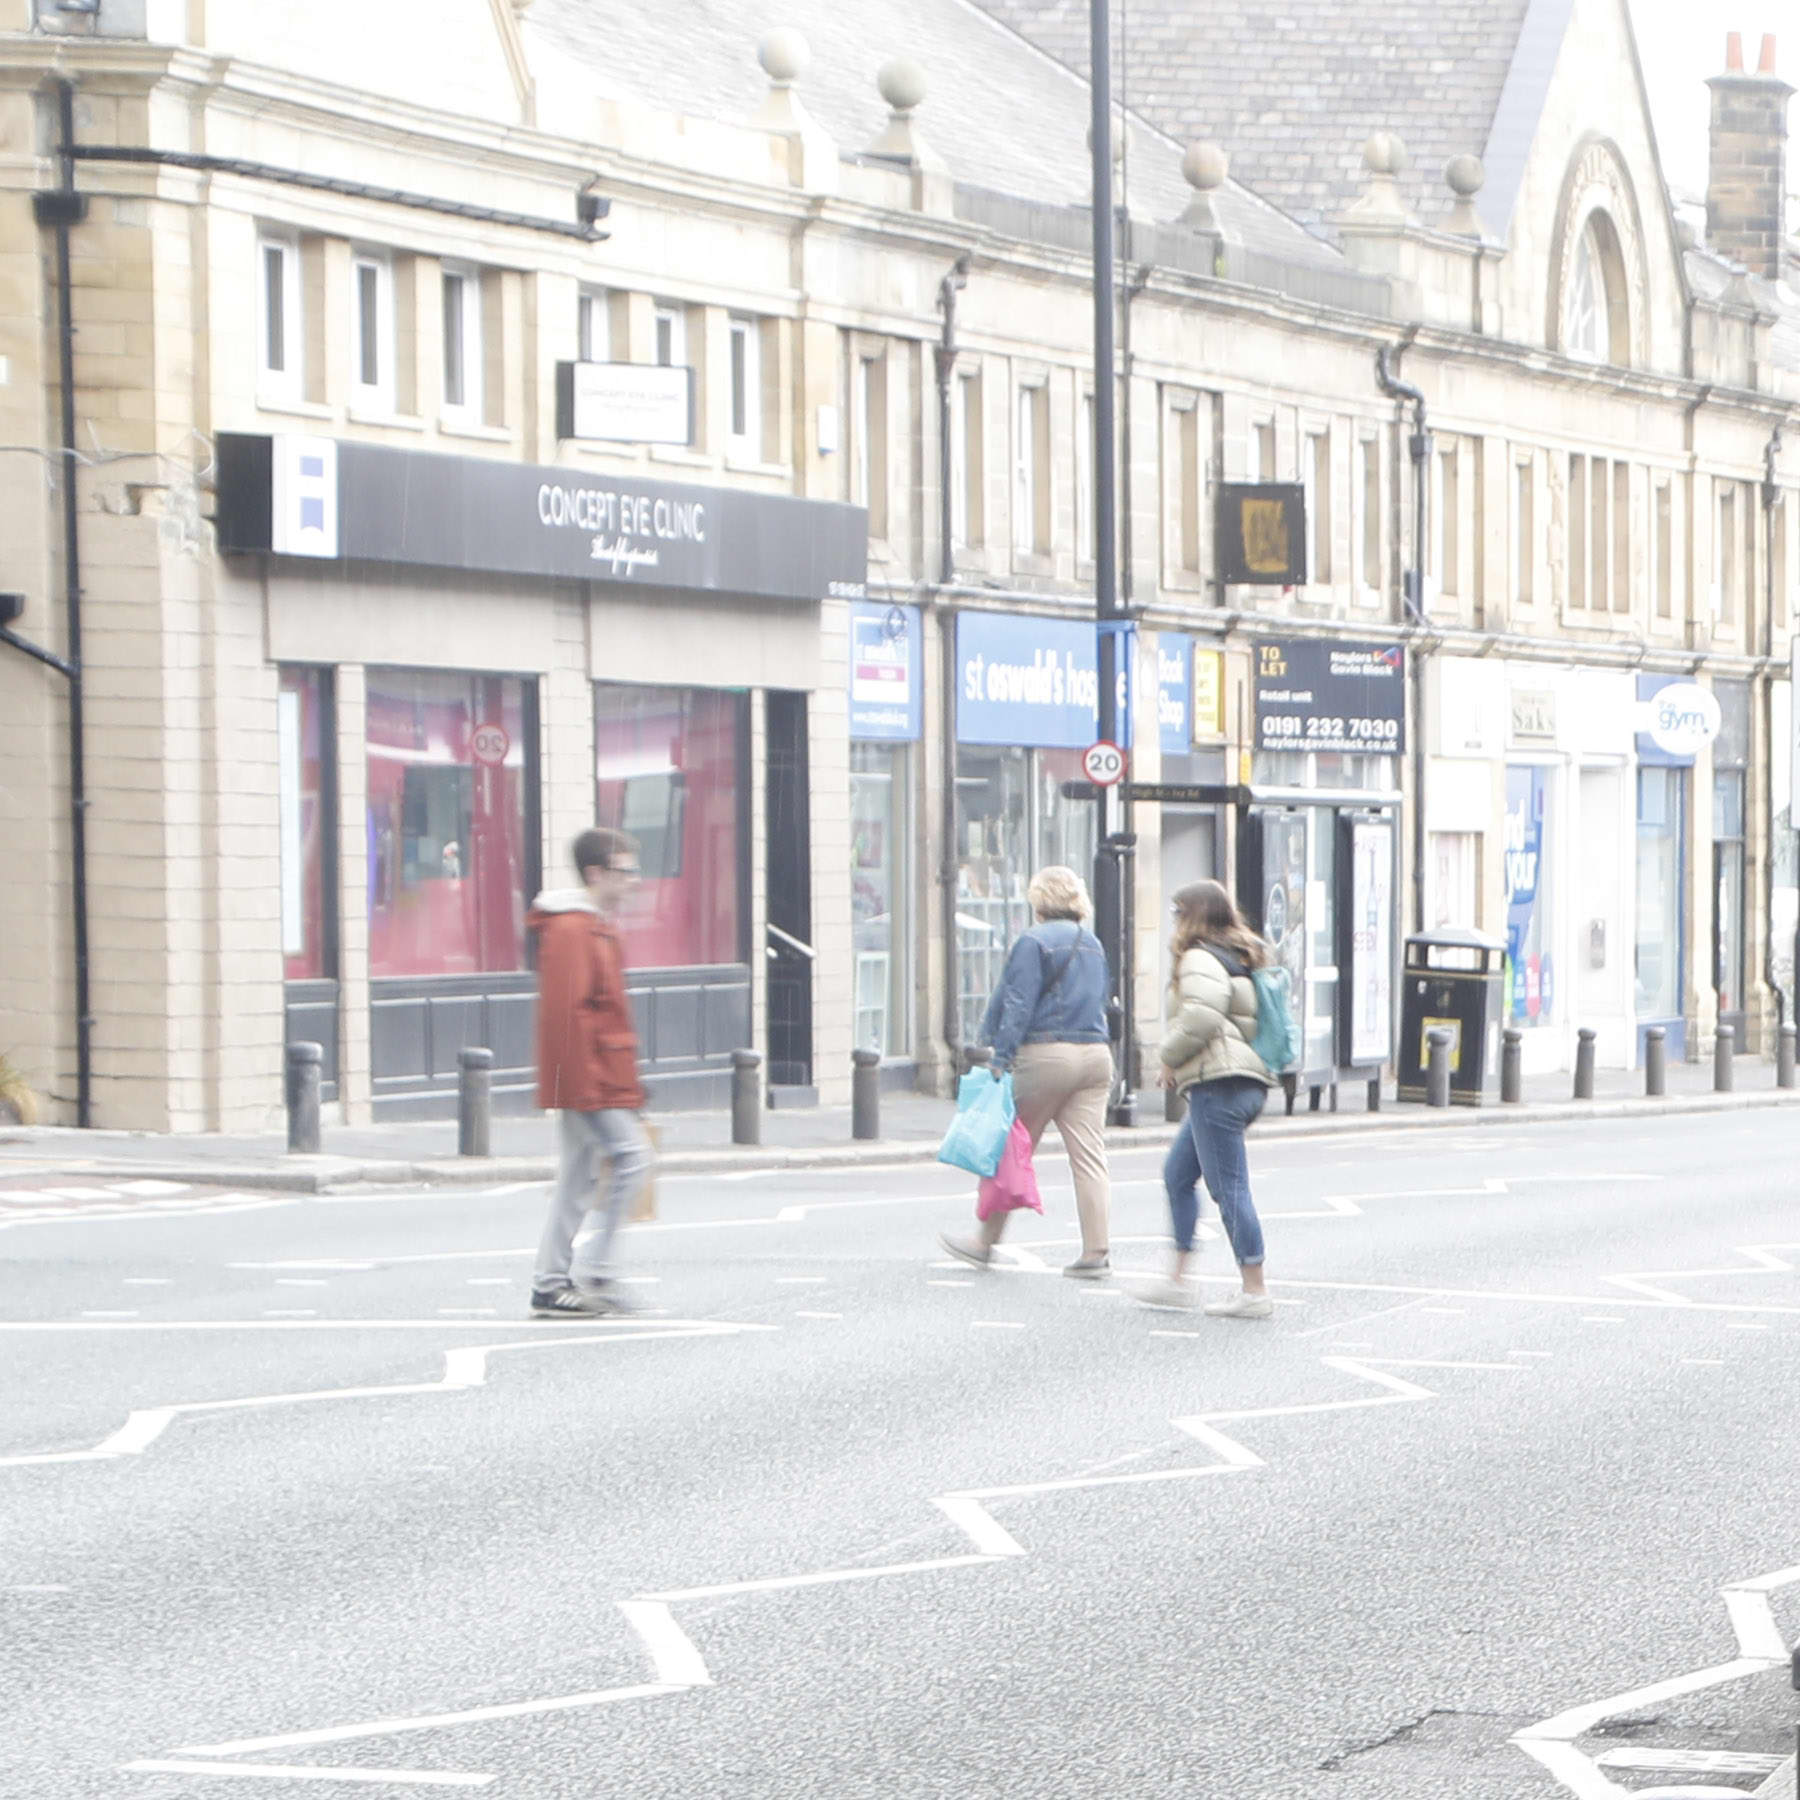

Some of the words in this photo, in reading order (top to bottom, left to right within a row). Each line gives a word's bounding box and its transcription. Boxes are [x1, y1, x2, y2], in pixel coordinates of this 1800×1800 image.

[538, 484, 616, 531] CONCEPT
[620, 494, 651, 537] EYE
[653, 498, 706, 543] CLINIC
[1260, 646, 1280, 660] TO
[1330, 652, 1372, 664] Naylors
[965, 653, 984, 701] st
[987, 648, 1063, 705] oswald's
[1260, 662, 1288, 676] LET
[1330, 664, 1361, 676] Gavin
[1362, 664, 1394, 677] Black
[1259, 690, 1290, 702] Retail
[1291, 691, 1314, 703] unit
[1512, 705, 1554, 731] Saks
[1262, 715, 1302, 736] 0191
[1306, 717, 1345, 738] 232
[1348, 718, 1399, 739] 7030
[1088, 753, 1120, 771] 20
